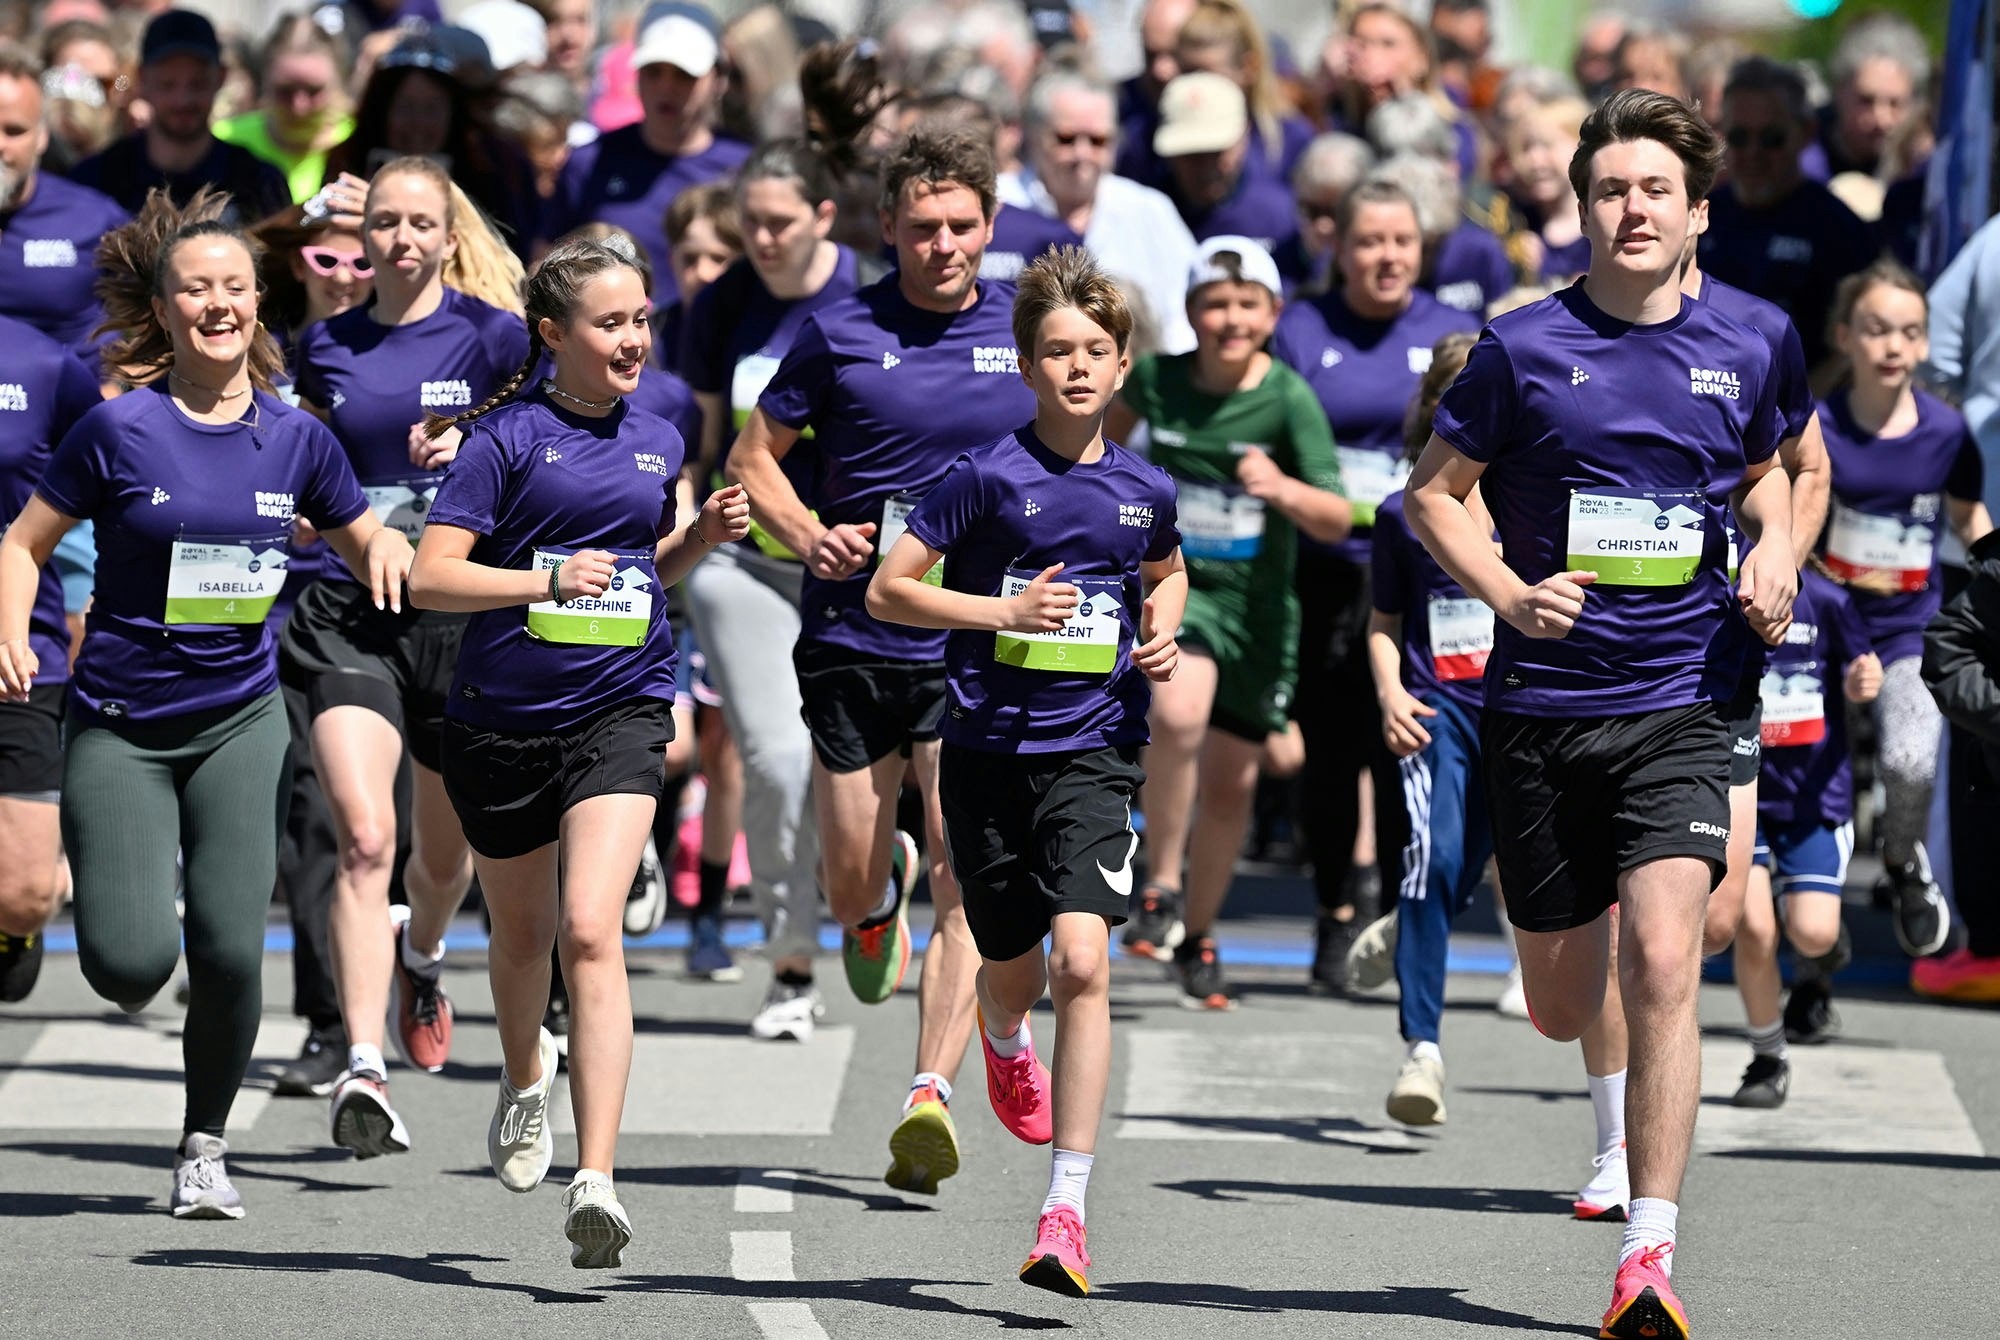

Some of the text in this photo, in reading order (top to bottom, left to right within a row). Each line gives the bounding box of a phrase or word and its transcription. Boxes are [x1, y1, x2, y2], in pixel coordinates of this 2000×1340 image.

[1690, 367, 1741, 386] ROYAL
[421, 379, 471, 393] ROYAL
[634, 453, 666, 467] ROYAL
[255, 491, 294, 506] ROYAL
[1579, 499, 1609, 507] ROYAL
[1119, 504, 1154, 518] ROYAL
[181, 547, 207, 555] ROYAL
[1597, 539, 1678, 552] CHRISTIAN
[1632, 560, 1642, 575] 3
[198, 582, 264, 593] ISABELLA
[224, 600, 235, 614] 4
[556, 599, 632, 613] OSEPHINE
[589, 620, 599, 635] 6
[1036, 626, 1094, 638] INCENT
[1056, 645, 1066, 661] 5
[1689, 821, 1728, 840] CRAFT
